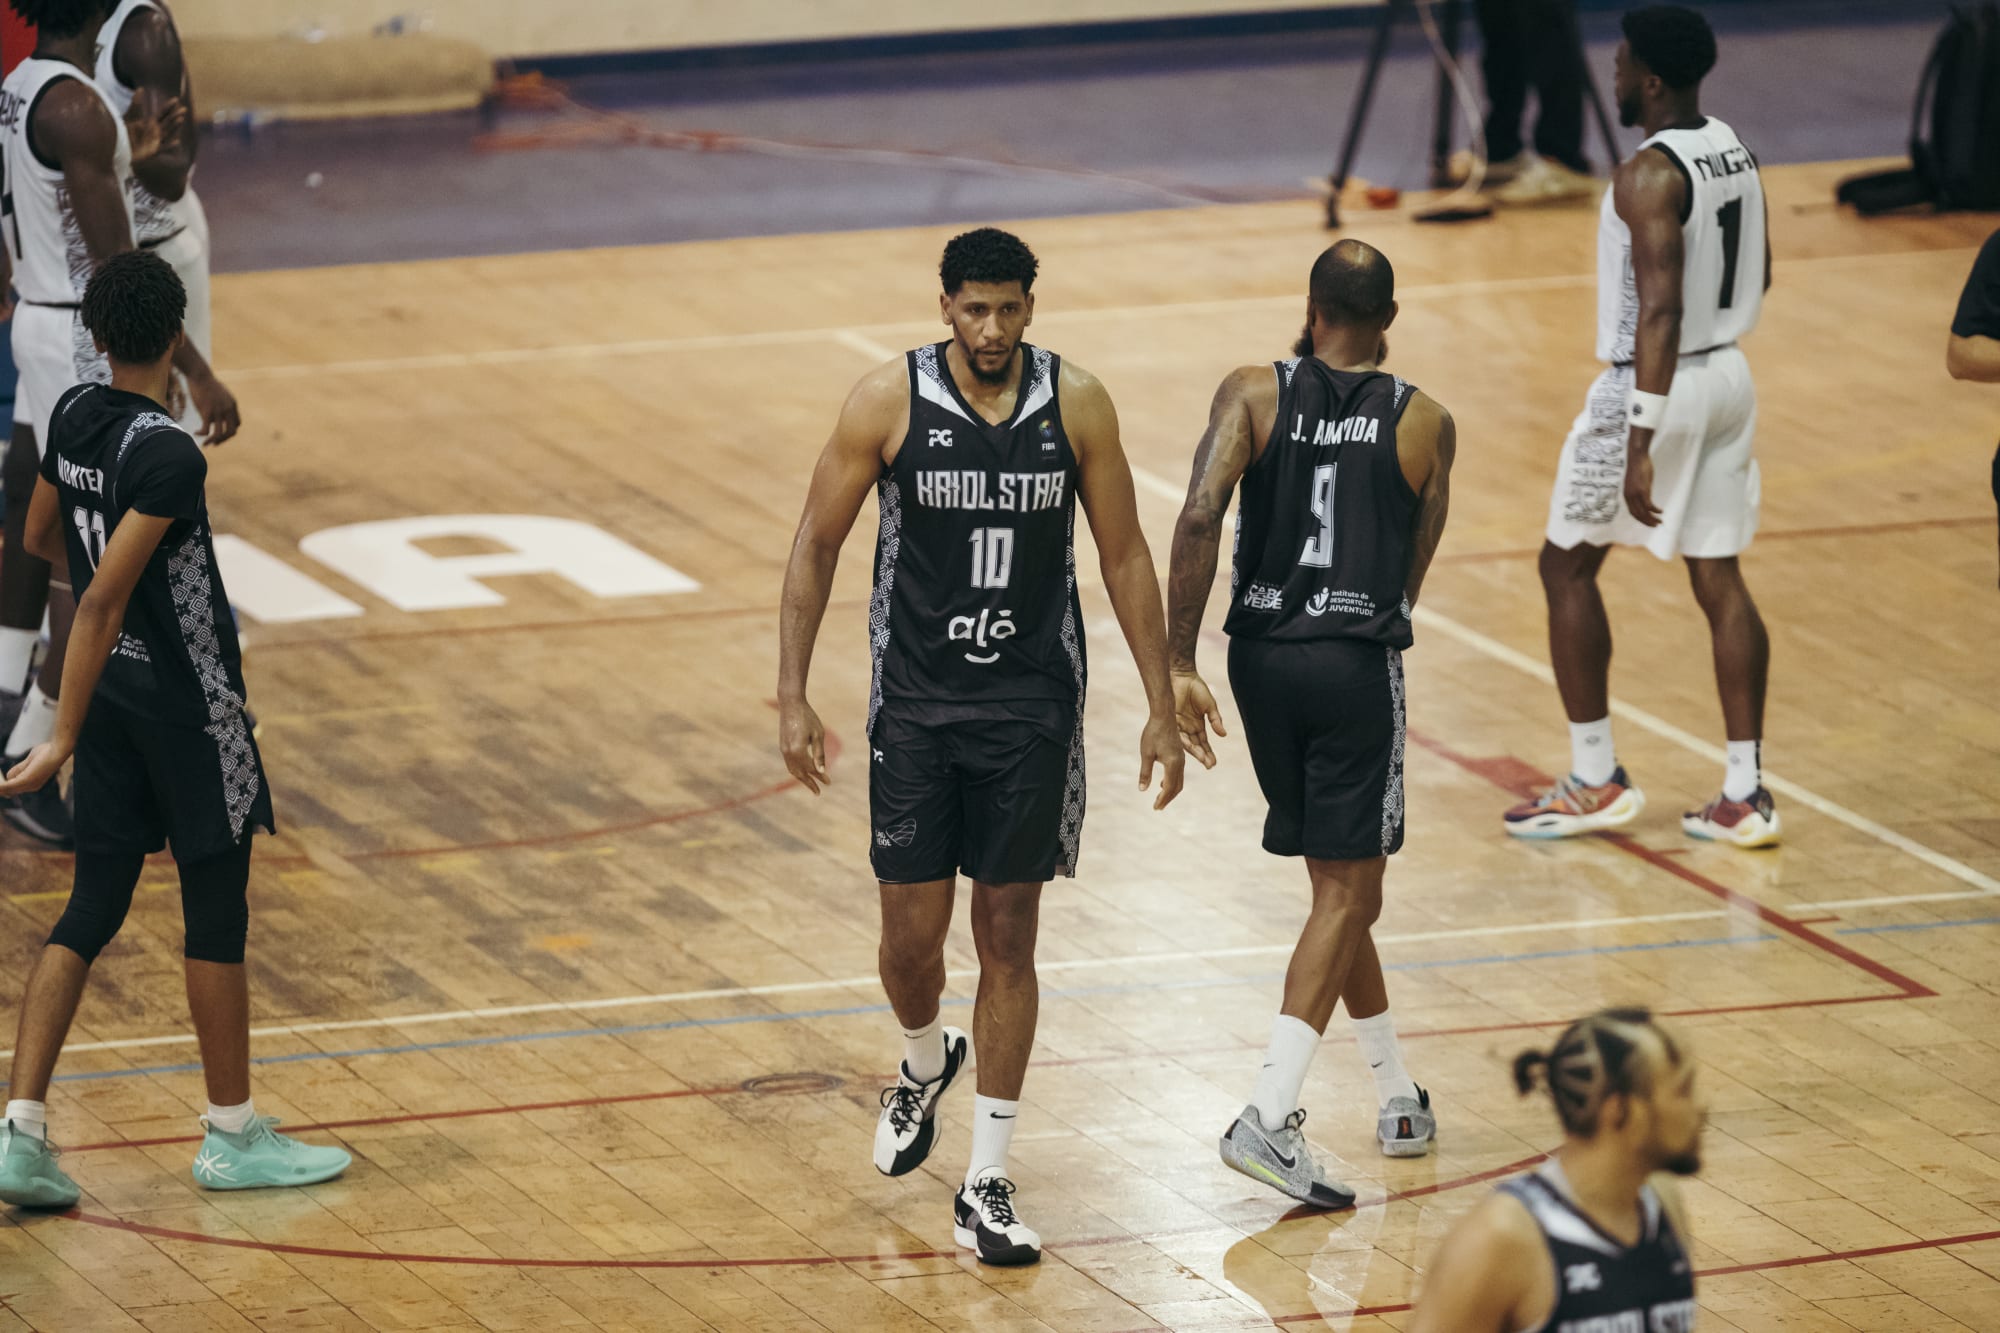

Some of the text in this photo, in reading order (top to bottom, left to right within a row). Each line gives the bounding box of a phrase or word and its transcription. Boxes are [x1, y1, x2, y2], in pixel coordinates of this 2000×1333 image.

[1716, 196, 1742, 309] 1
[1290, 413, 1307, 442] J.
[998, 470, 1066, 513] STAR
[1298, 462, 1338, 568] 9
[968, 527, 1014, 589] 10
[1328, 604, 1375, 617] JUVENTUDE
